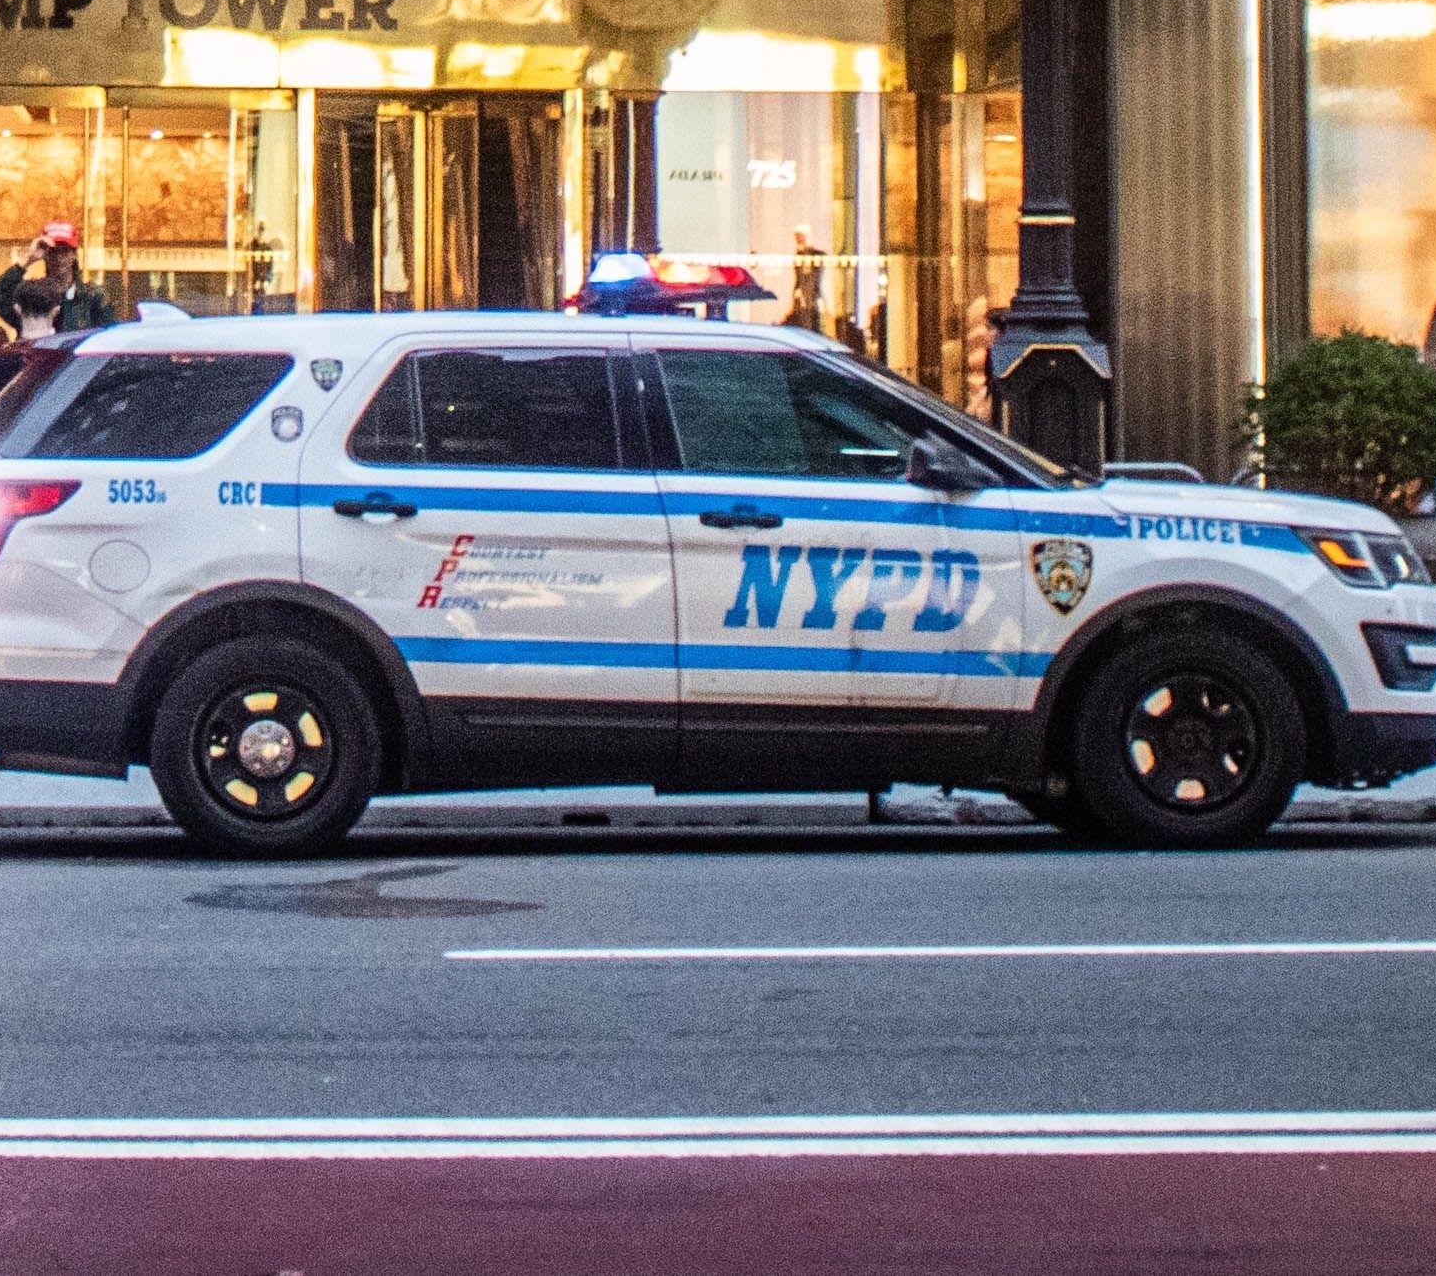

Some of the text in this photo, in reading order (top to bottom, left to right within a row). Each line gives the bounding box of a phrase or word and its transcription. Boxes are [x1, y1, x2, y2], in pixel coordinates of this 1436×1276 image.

[108, 479, 157, 505] 5053
[218, 481, 257, 506] CRC
[1138, 516, 1235, 543] POLICE
[723, 544, 981, 632] NYPD
